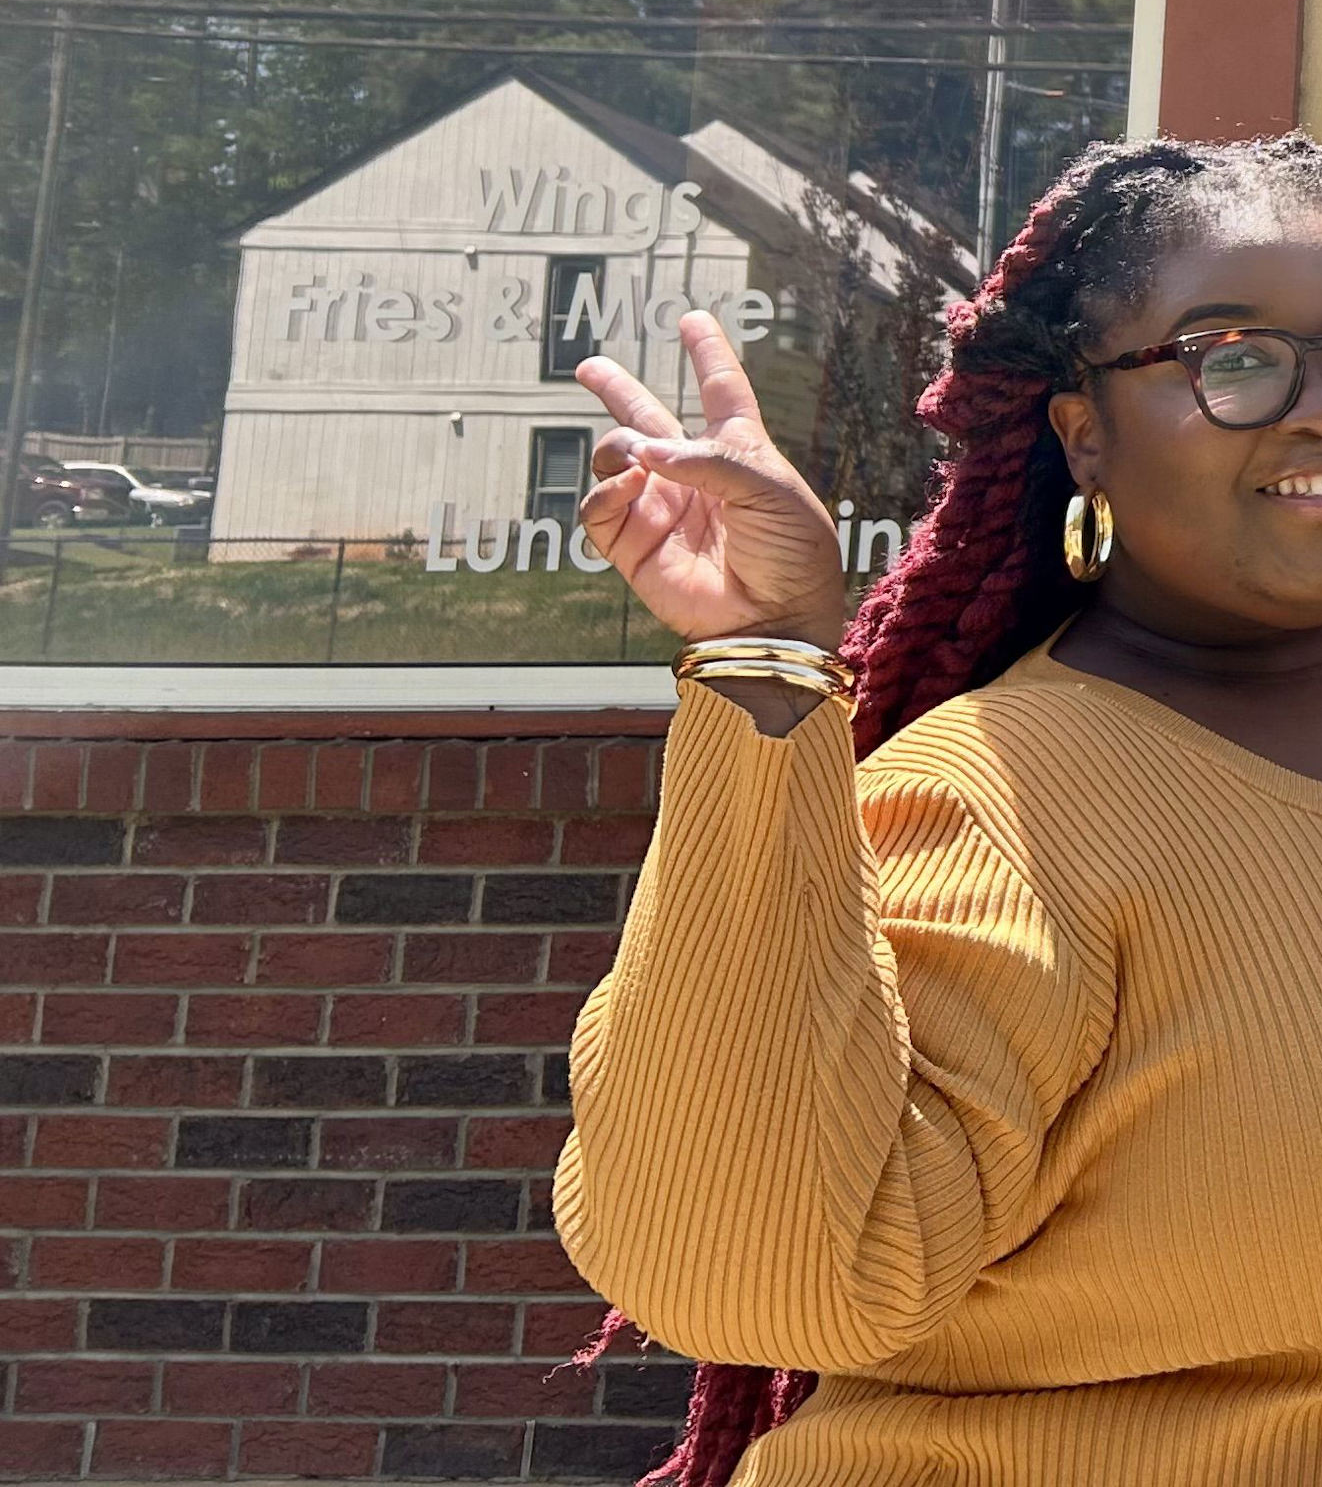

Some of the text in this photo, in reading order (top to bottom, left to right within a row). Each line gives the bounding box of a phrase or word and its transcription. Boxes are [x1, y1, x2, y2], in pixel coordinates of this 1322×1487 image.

[481, 165, 702, 253] Wings
[283, 271, 462, 342] Fries
[484, 277, 538, 342] &
[425, 501, 615, 573] Lunc
